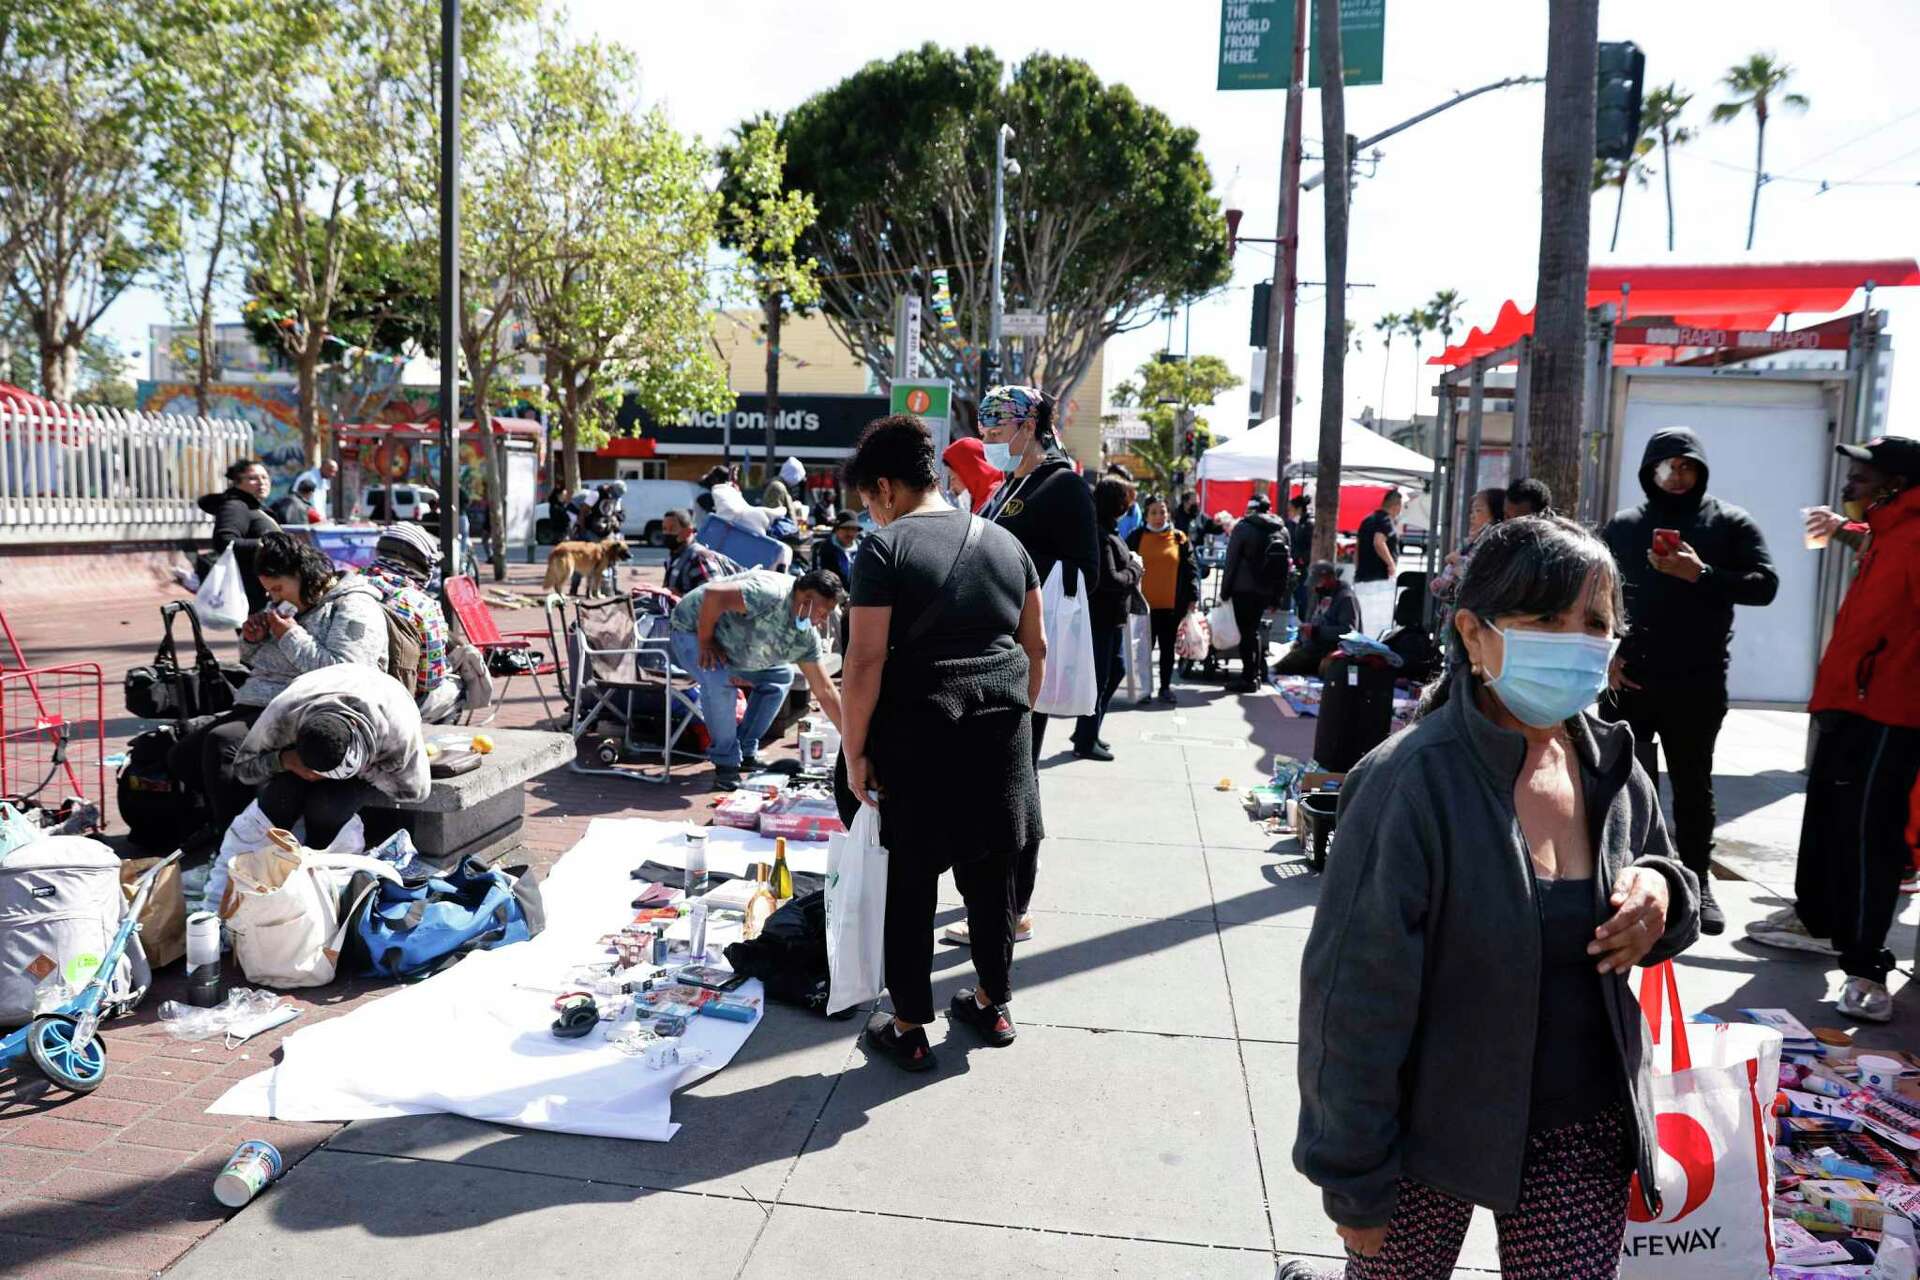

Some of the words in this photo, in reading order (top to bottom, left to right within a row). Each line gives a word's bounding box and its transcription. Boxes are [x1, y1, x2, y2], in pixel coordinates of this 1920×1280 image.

[1227, 5, 1249, 19] THE
[1225, 18, 1270, 33] WORLD
[1224, 34, 1260, 48] FROM
[1223, 48, 1258, 64] HERE.
[1680, 328, 1727, 347] RAPID
[1773, 331, 1820, 349] RAPID
[1622, 1226, 1721, 1257] AFEWAY
